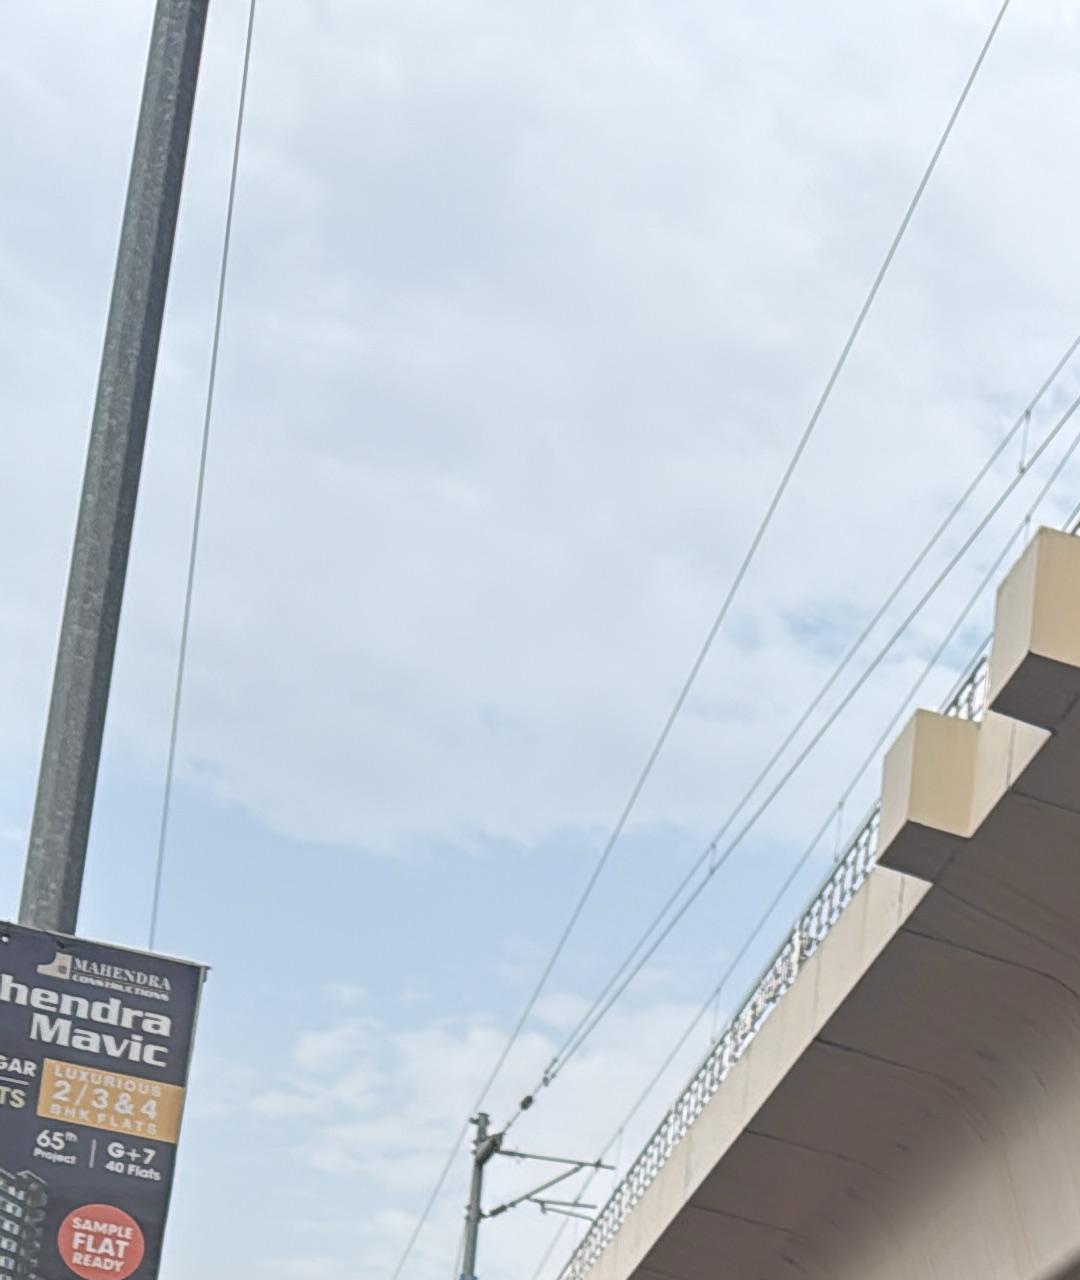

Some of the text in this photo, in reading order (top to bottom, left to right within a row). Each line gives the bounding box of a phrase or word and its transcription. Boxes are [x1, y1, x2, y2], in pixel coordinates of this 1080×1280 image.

[73, 957, 172, 991] MAHENDRA
[72, 974, 170, 1001] CONSTRUCTIONS
[0, 973, 172, 1037] hendra
[29, 1012, 169, 1067] Mavic
[53, 1064, 162, 1098] LUXURIOUS
[140, 1099, 158, 1121] 4
[97, 1113, 158, 1135] FLATS
[33, 1147, 77, 1165] Project
[107, 1142, 156, 1165] G+7
[105, 1160, 161, 1181] 40 Flats
[72, 1216, 134, 1239] SAMPLE
[72, 1231, 130, 1259] FLAT
[71, 1252, 125, 1273] READY
